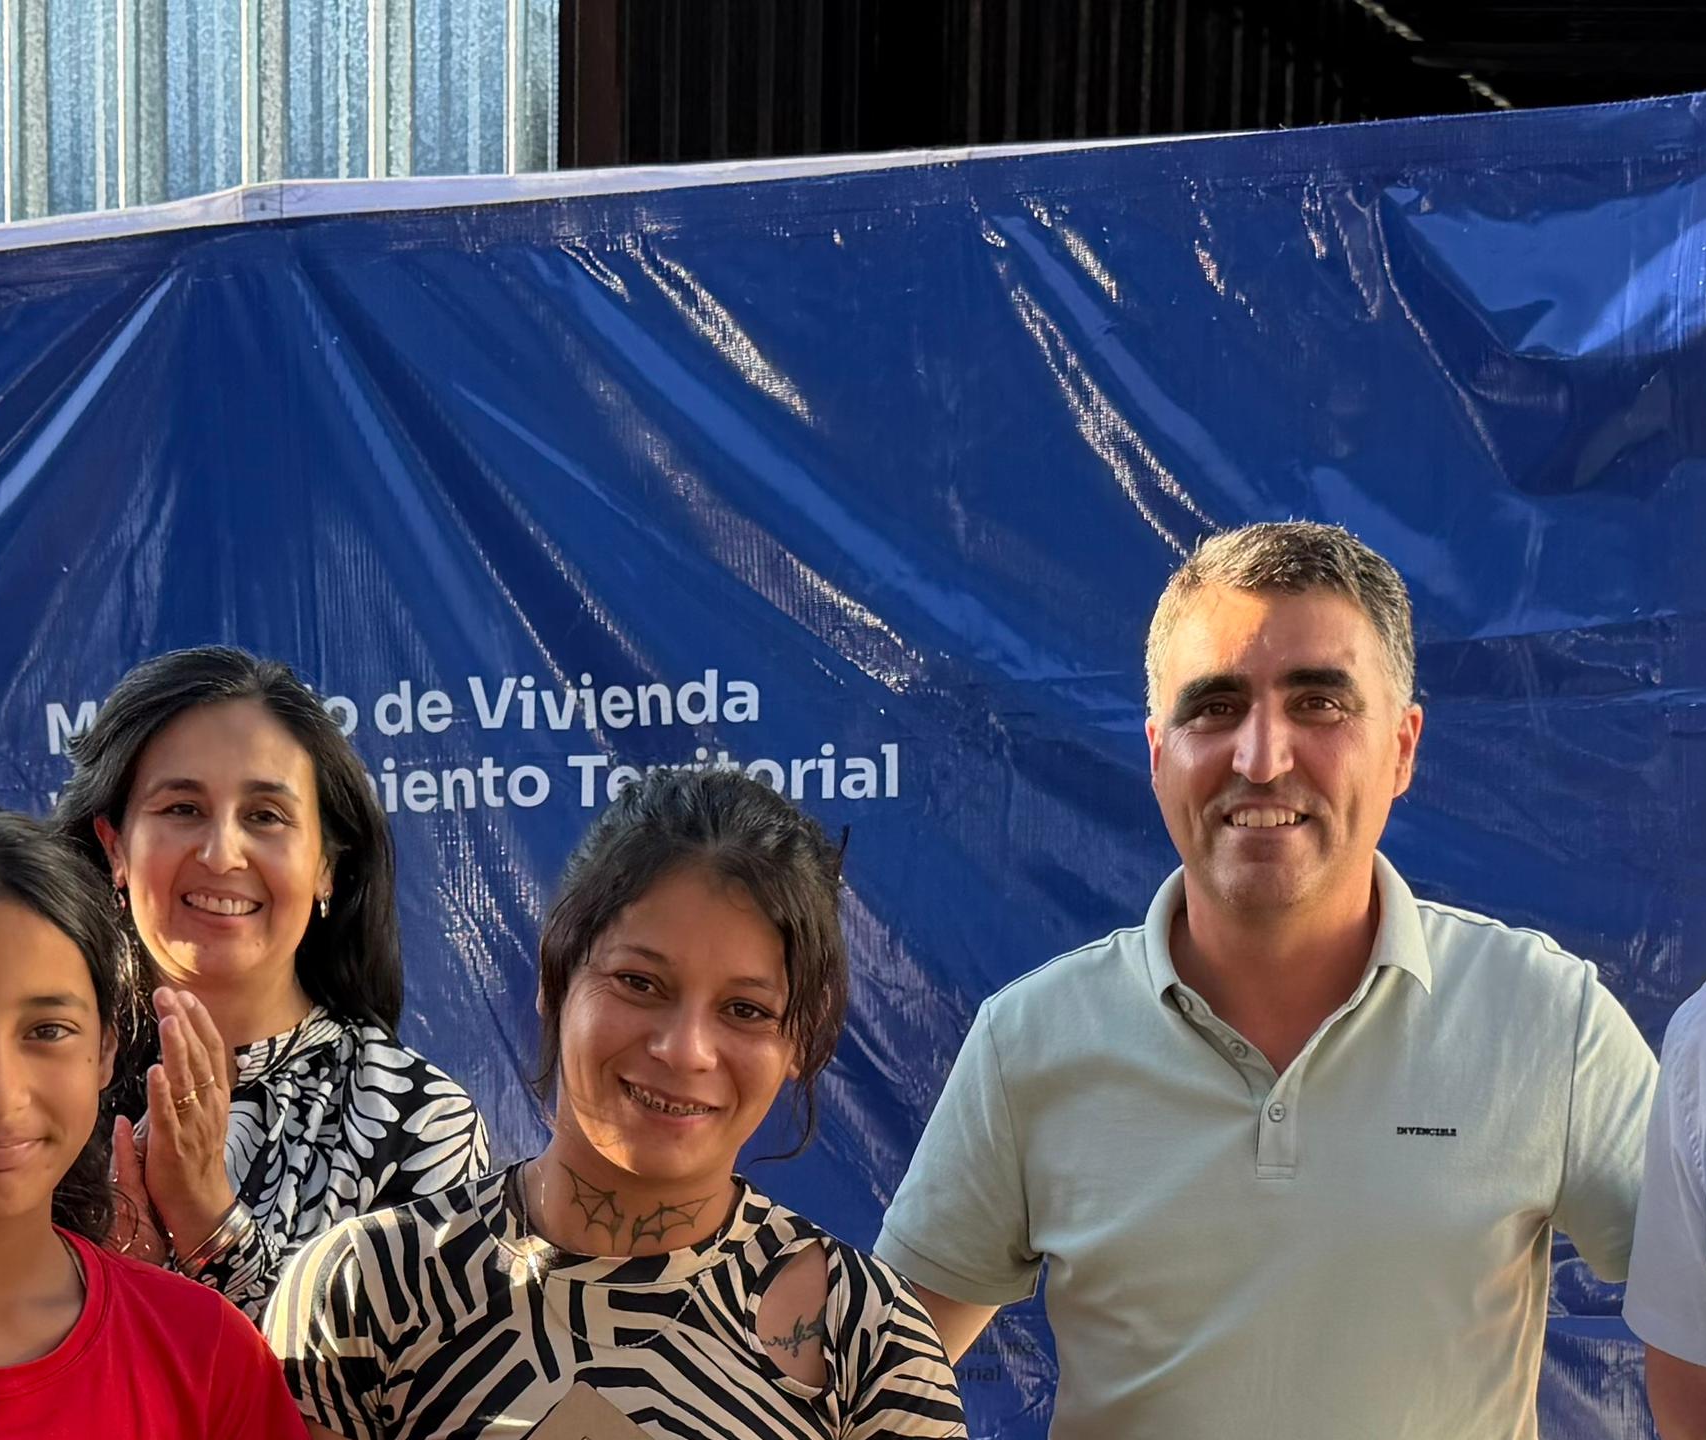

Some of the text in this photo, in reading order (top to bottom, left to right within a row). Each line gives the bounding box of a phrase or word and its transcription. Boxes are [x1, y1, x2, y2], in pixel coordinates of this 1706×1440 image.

[373, 680, 454, 737] de
[467, 668, 760, 731] Vivienda
[566, 742, 899, 808] Teorial
[1396, 1126, 1457, 1137] INVENCIBLE
